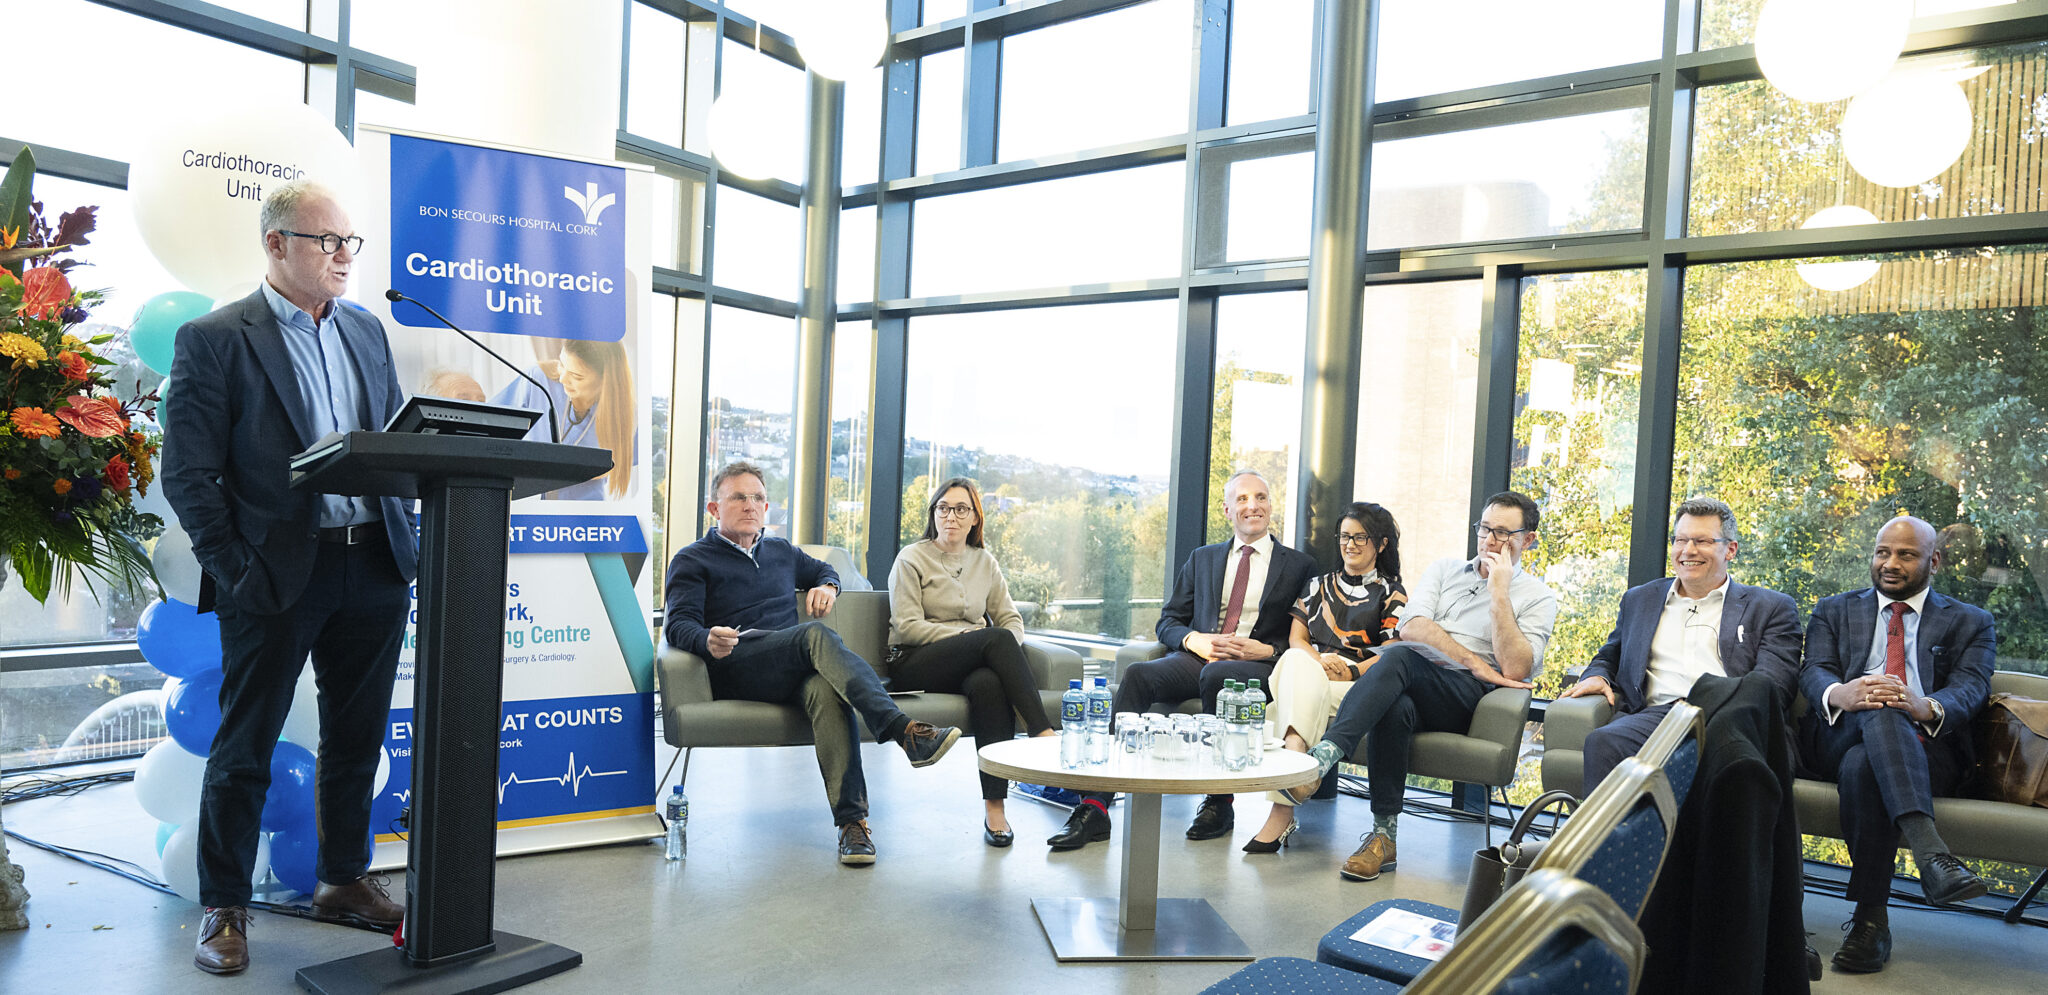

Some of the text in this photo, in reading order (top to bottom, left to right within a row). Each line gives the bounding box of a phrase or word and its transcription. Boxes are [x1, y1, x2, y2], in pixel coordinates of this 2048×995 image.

[227, 178, 262, 201] Unit
[419, 205, 598, 237] BON SECOURS HOSPITAL CORK
[405, 252, 614, 295] Cardiothoracic
[486, 288, 543, 316] Unit
[532, 526, 624, 542] SURGERY
[531, 625, 591, 644] Centre
[538, 652, 577, 663] Cardiology.
[535, 706, 623, 729] COUNTS
